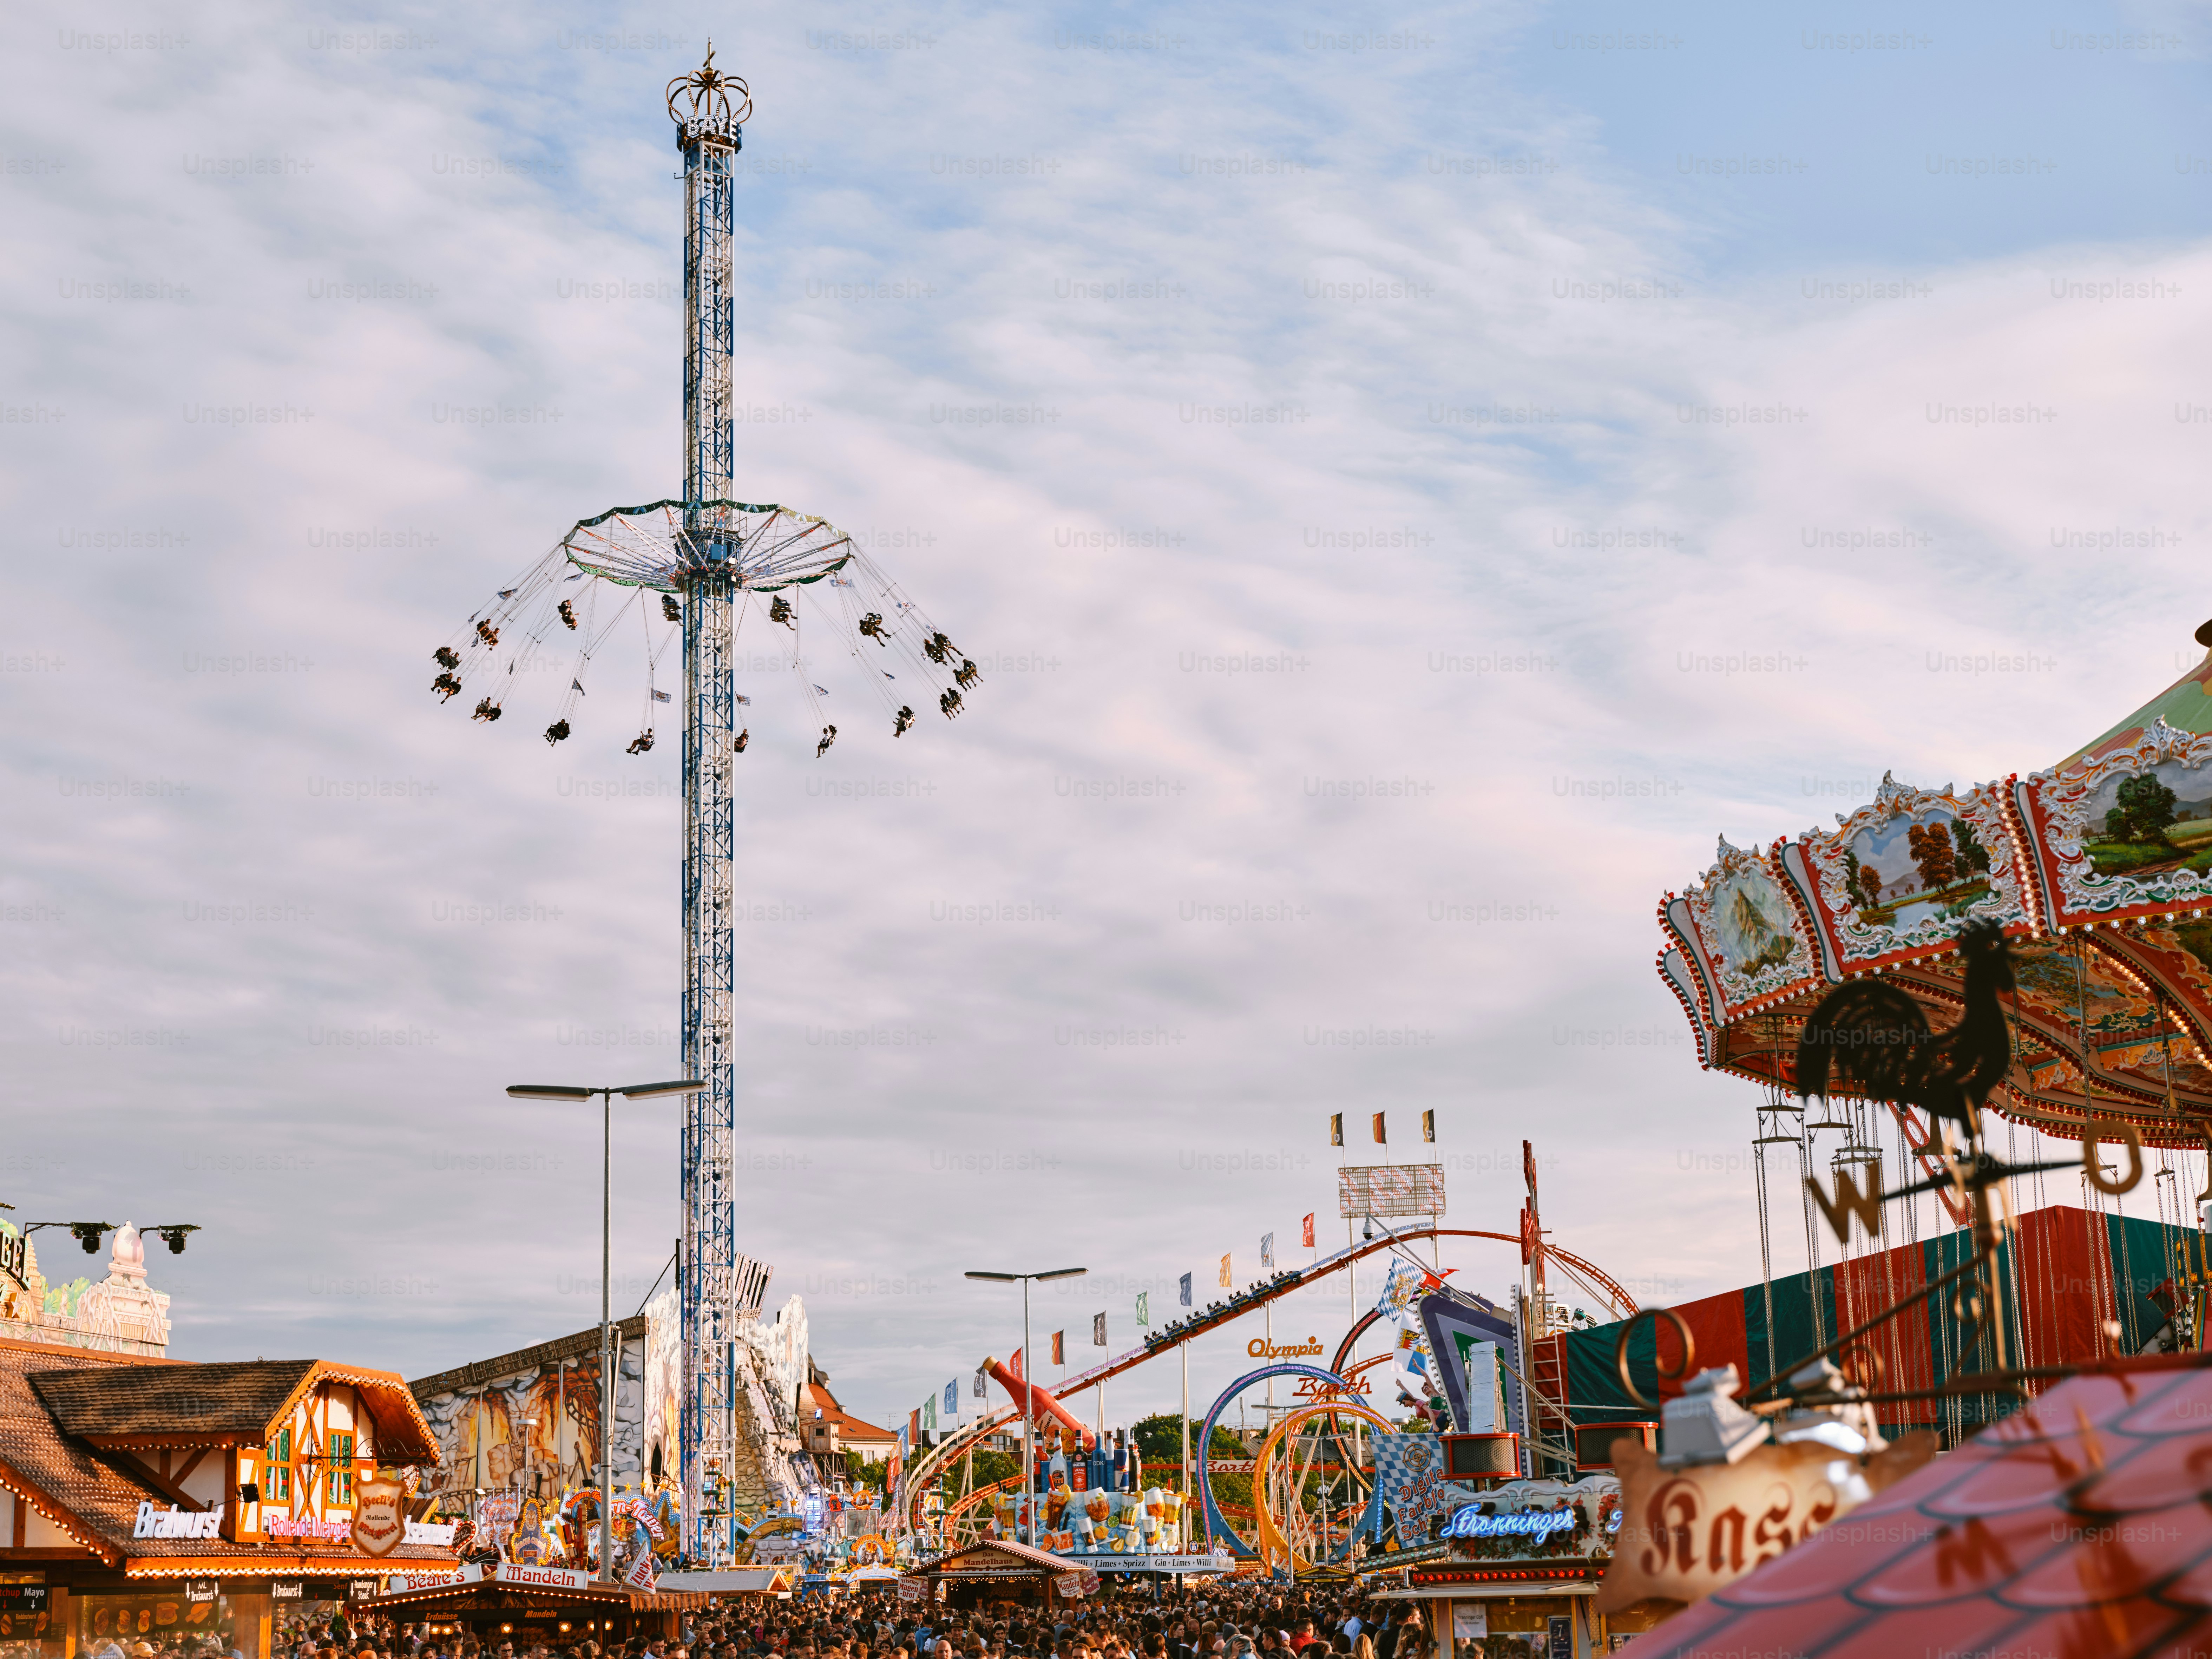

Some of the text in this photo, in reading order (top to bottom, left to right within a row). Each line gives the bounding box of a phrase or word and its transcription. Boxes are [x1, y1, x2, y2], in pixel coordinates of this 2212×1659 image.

[687, 114, 738, 141] BAYE
[2, 1232, 31, 1291] GEL
[1247, 1336, 1324, 1359] Olympia
[1293, 1376, 1372, 1396] Barth
[1398, 1468, 1443, 1501] Digita
[133, 1502, 224, 1539] Bratwurst
[269, 1514, 352, 1541] Rollende Metzger
[1123, 1560, 1146, 1568] Sprizz
[506, 1566, 575, 1586] Mandeln
[276, 1585, 297, 1598] Bratwurst
[354, 1580, 373, 1591] Hamburger
[899, 1583, 918, 1593] Magen
[1058, 1580, 1079, 1591] Mandeln
[0, 1586, 45, 1599] tchup Mayo
[191, 1589, 214, 1601] Bratwurst
[358, 1591, 369, 1600] Steak
[900, 1591, 915, 1599] -brot
[425, 1612, 458, 1621] Erdnüsse
[525, 1610, 557, 1618] Mandeln
[1557, 1624, 1563, 1637] 7
